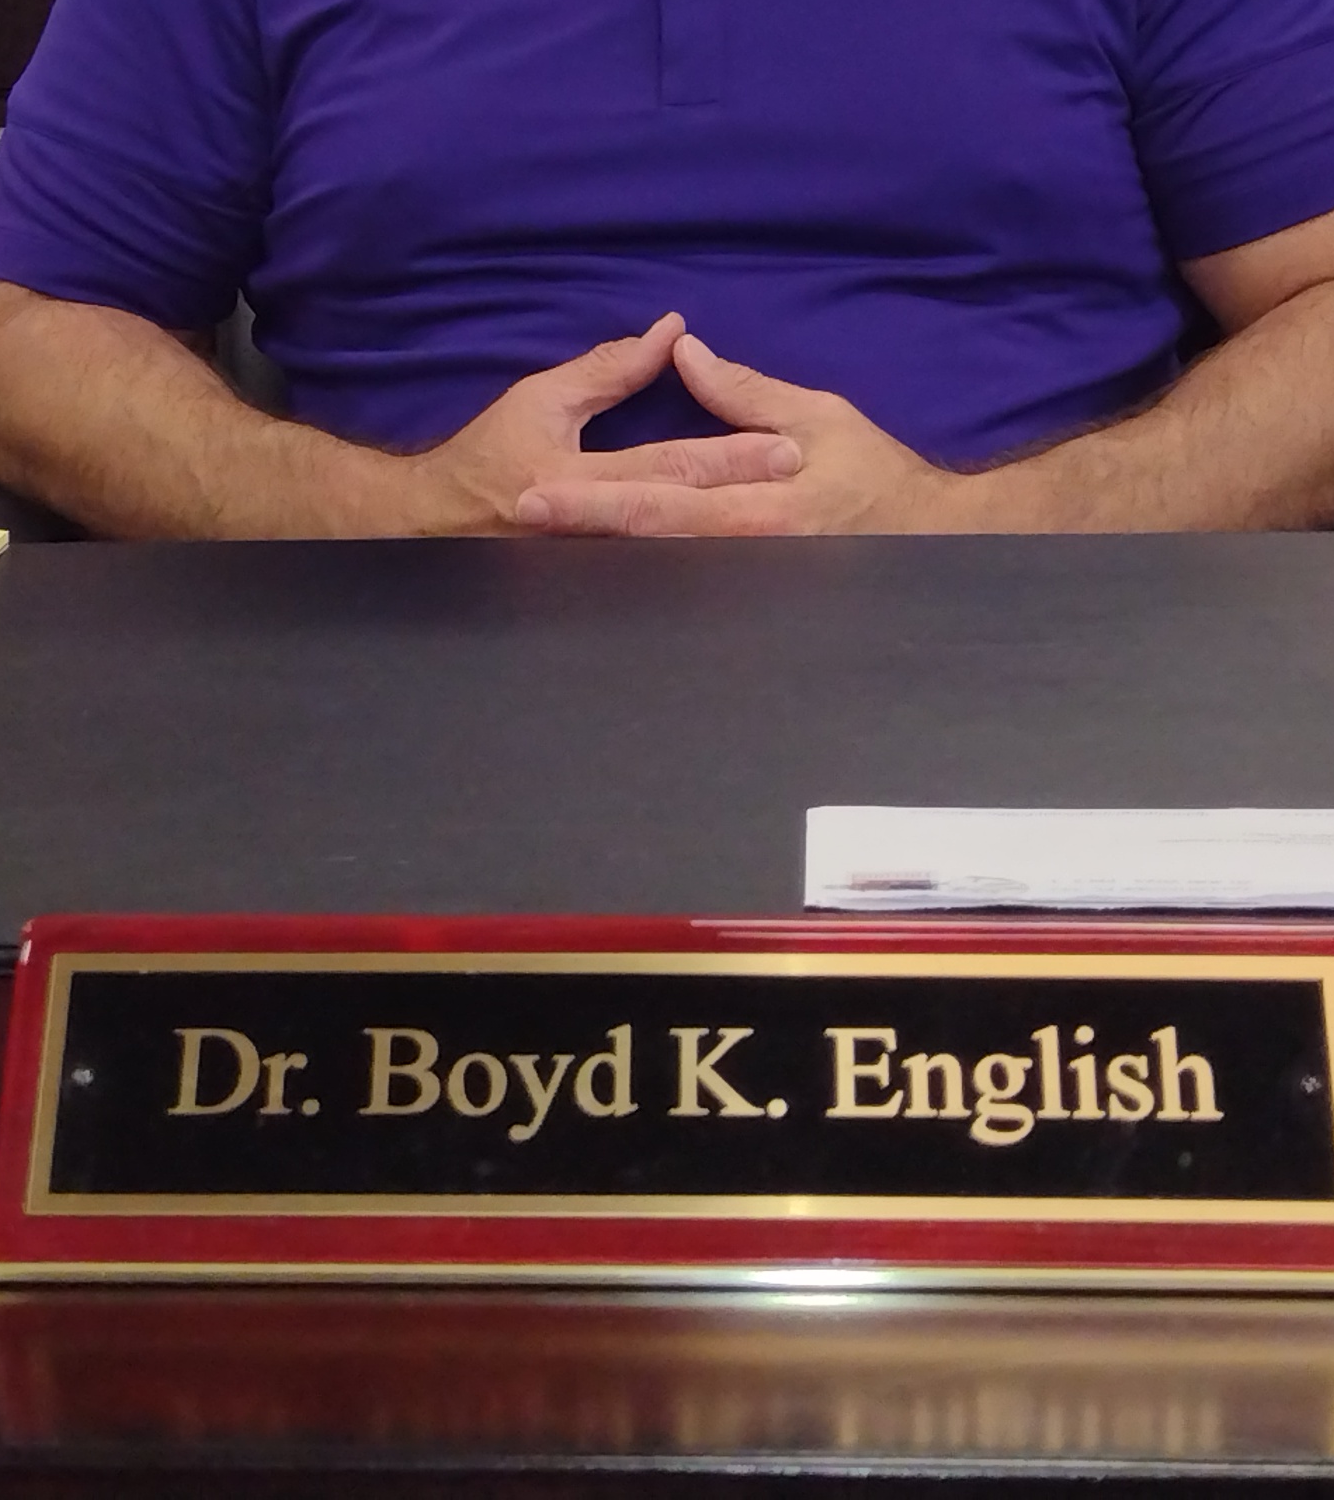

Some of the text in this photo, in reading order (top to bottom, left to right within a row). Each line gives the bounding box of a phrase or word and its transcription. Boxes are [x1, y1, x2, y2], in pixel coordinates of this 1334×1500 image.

[168, 1023, 1224, 1146] Dr. Boyd K. English
